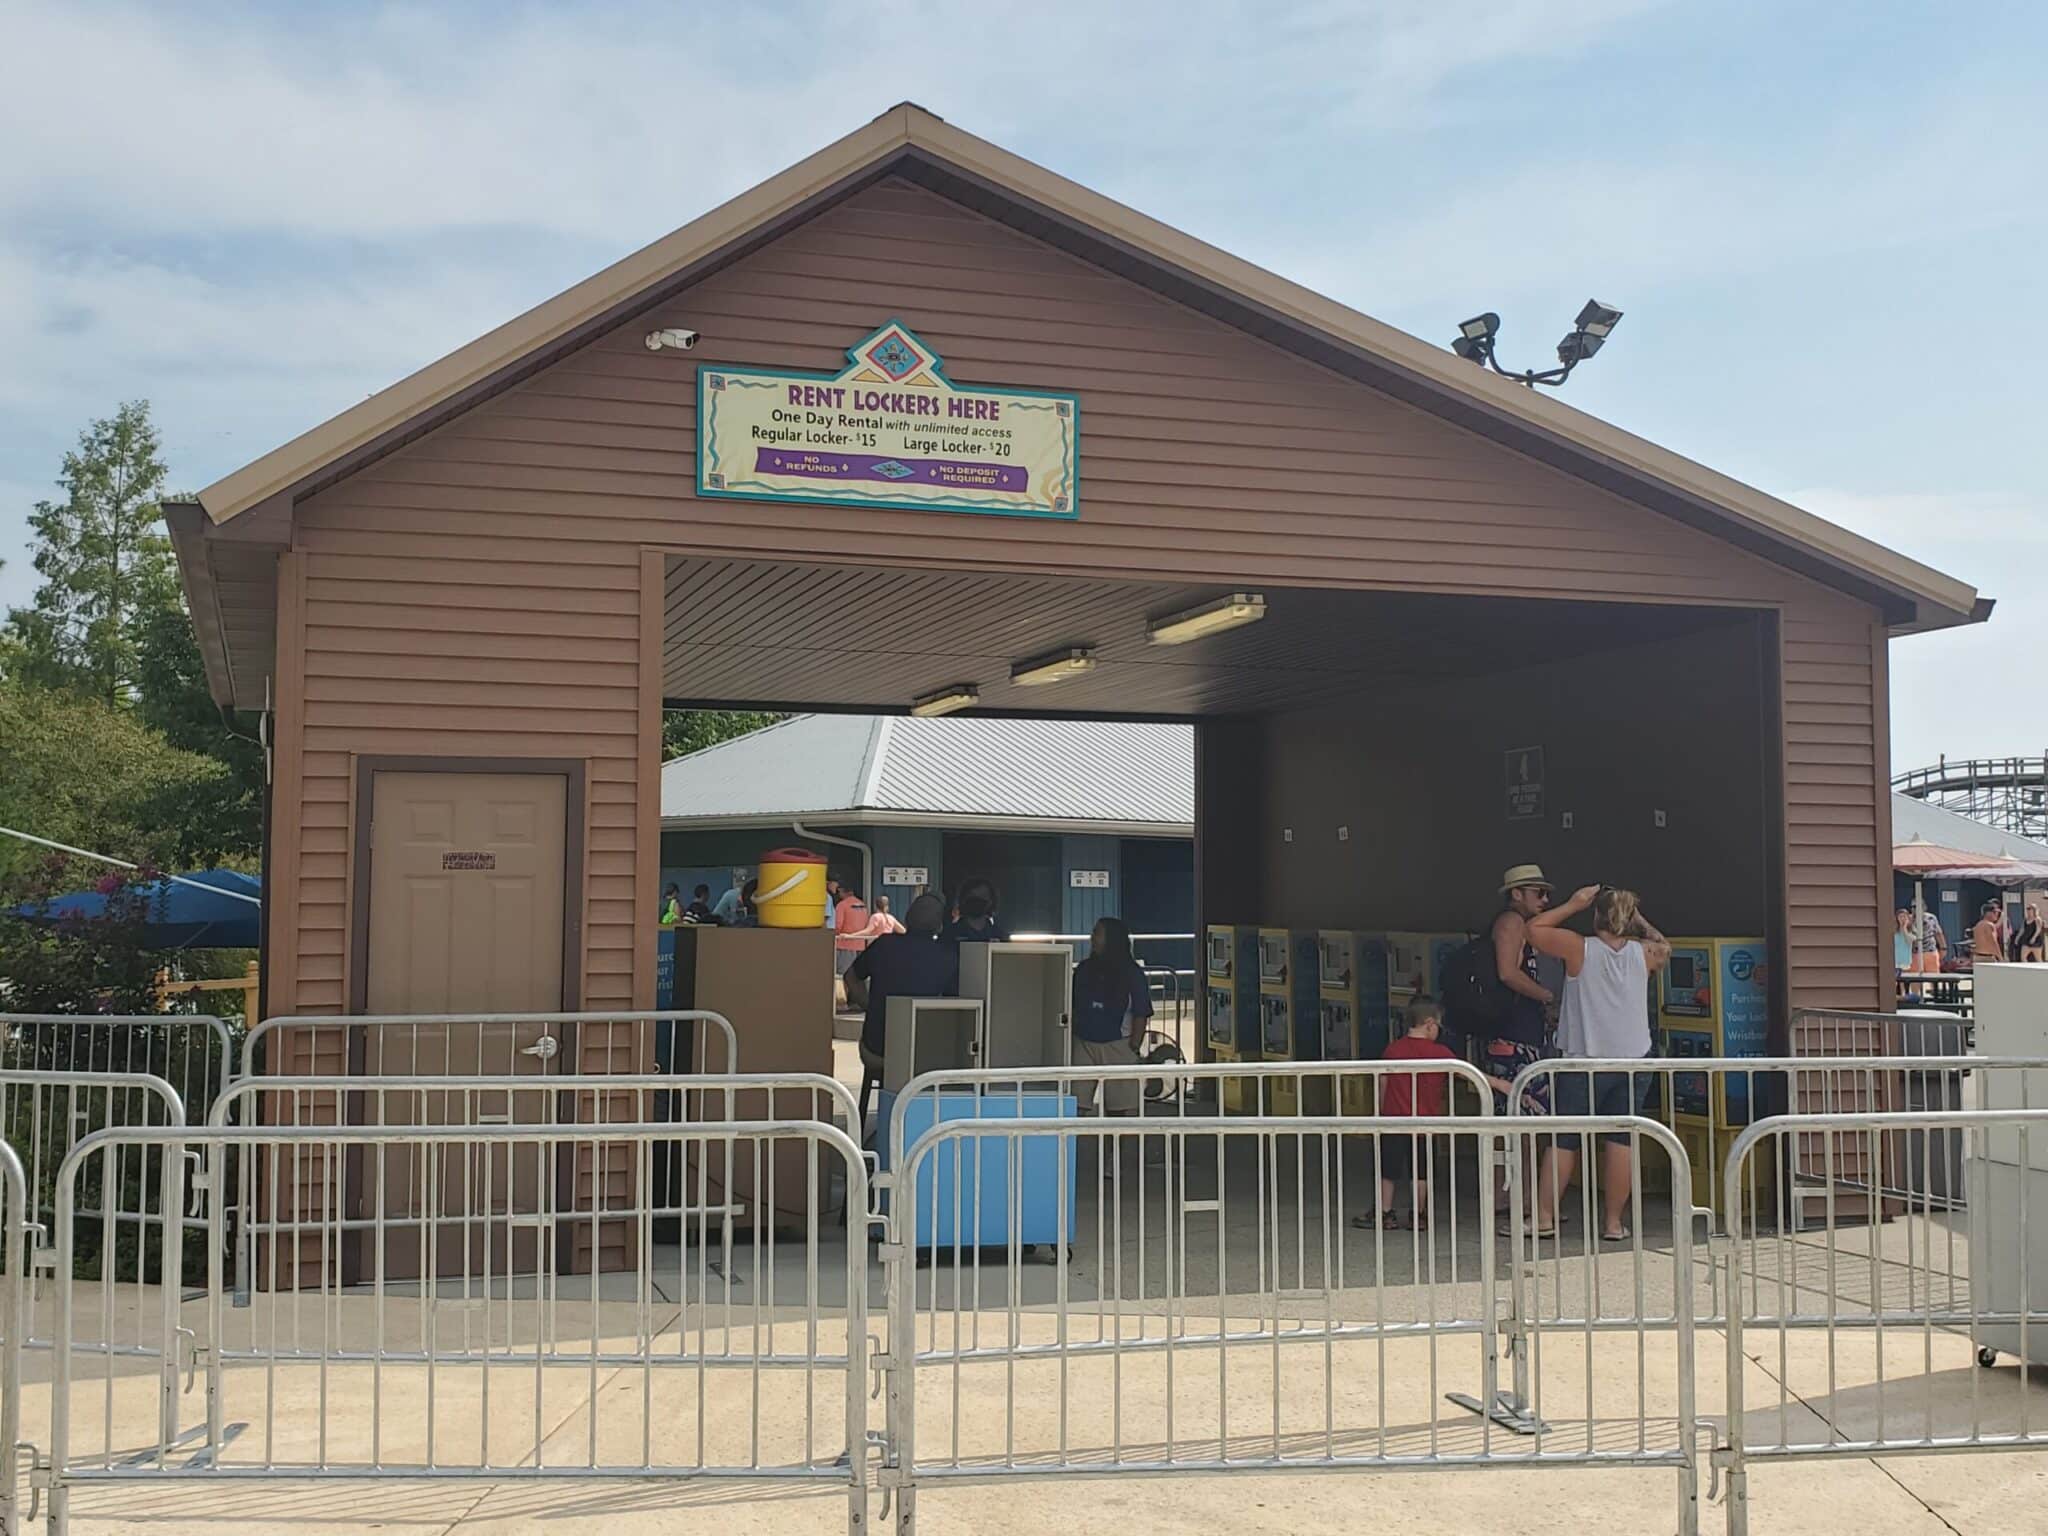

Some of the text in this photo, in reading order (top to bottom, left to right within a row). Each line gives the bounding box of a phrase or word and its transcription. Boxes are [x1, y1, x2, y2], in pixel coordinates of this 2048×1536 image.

[788, 384, 1000, 421] RENT LOCKERS HERE
[771, 409, 1013, 439] One Day Rental with unlimited access
[752, 425, 802, 444] Regular
[855, 432, 877, 448] $15
[903, 436, 938, 455] Large
[990, 441, 1011, 457] $20
[804, 455, 820, 465] NO
[786, 462, 838, 473] REFUNDS
[939, 465, 1001, 476] NO DEPOSIT
[943, 474, 997, 484] REQUIRED
[1726, 1012, 1747, 1022] Your
